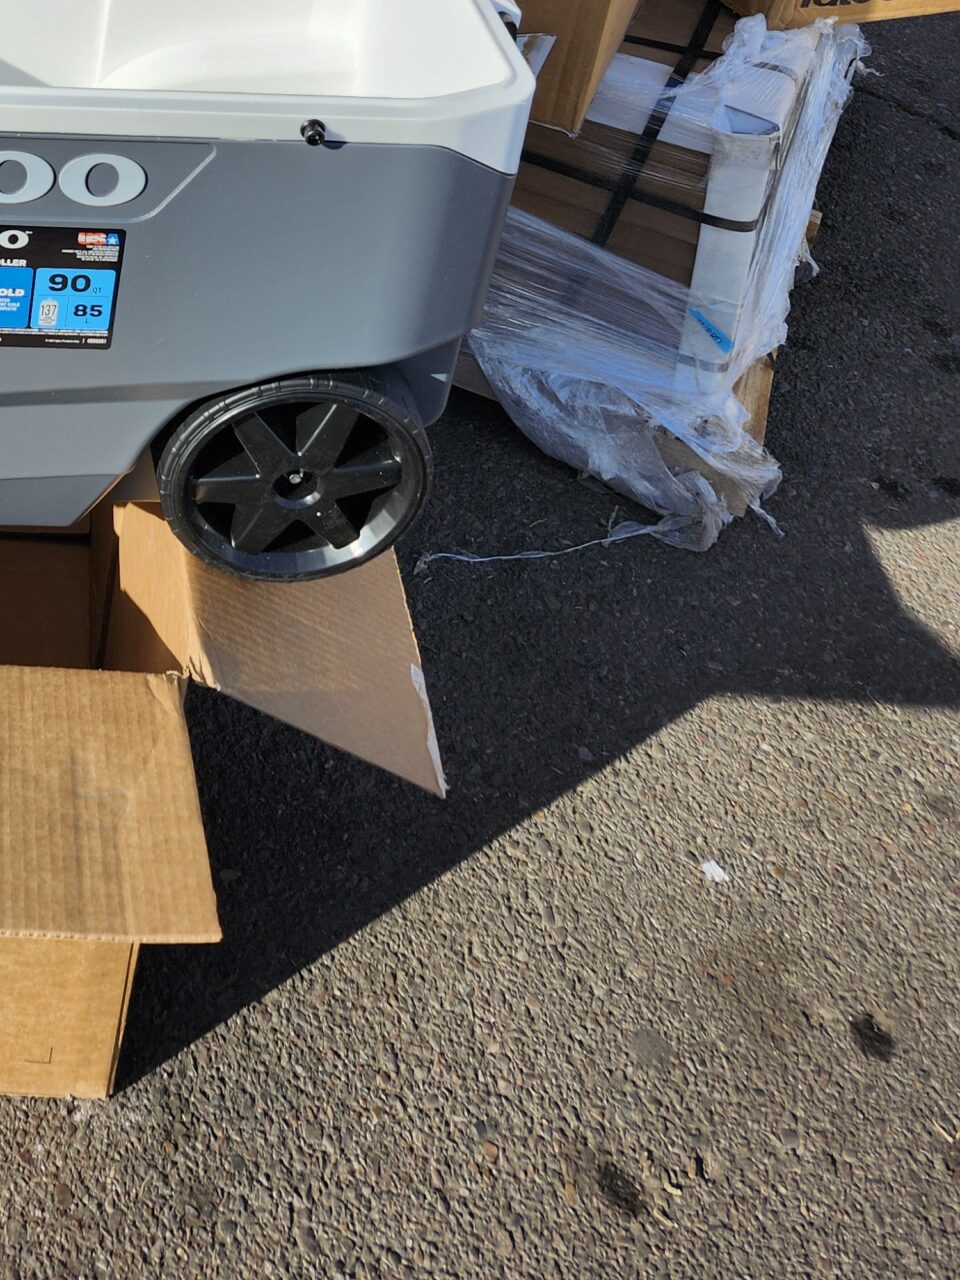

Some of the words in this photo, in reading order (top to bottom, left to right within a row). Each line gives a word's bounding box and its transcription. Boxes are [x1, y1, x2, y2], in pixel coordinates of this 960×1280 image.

[78, 231, 119, 245] USA
[48, 273, 91, 293] 90
[41, 304, 57, 316] 137
[73, 303, 103, 318] 85
